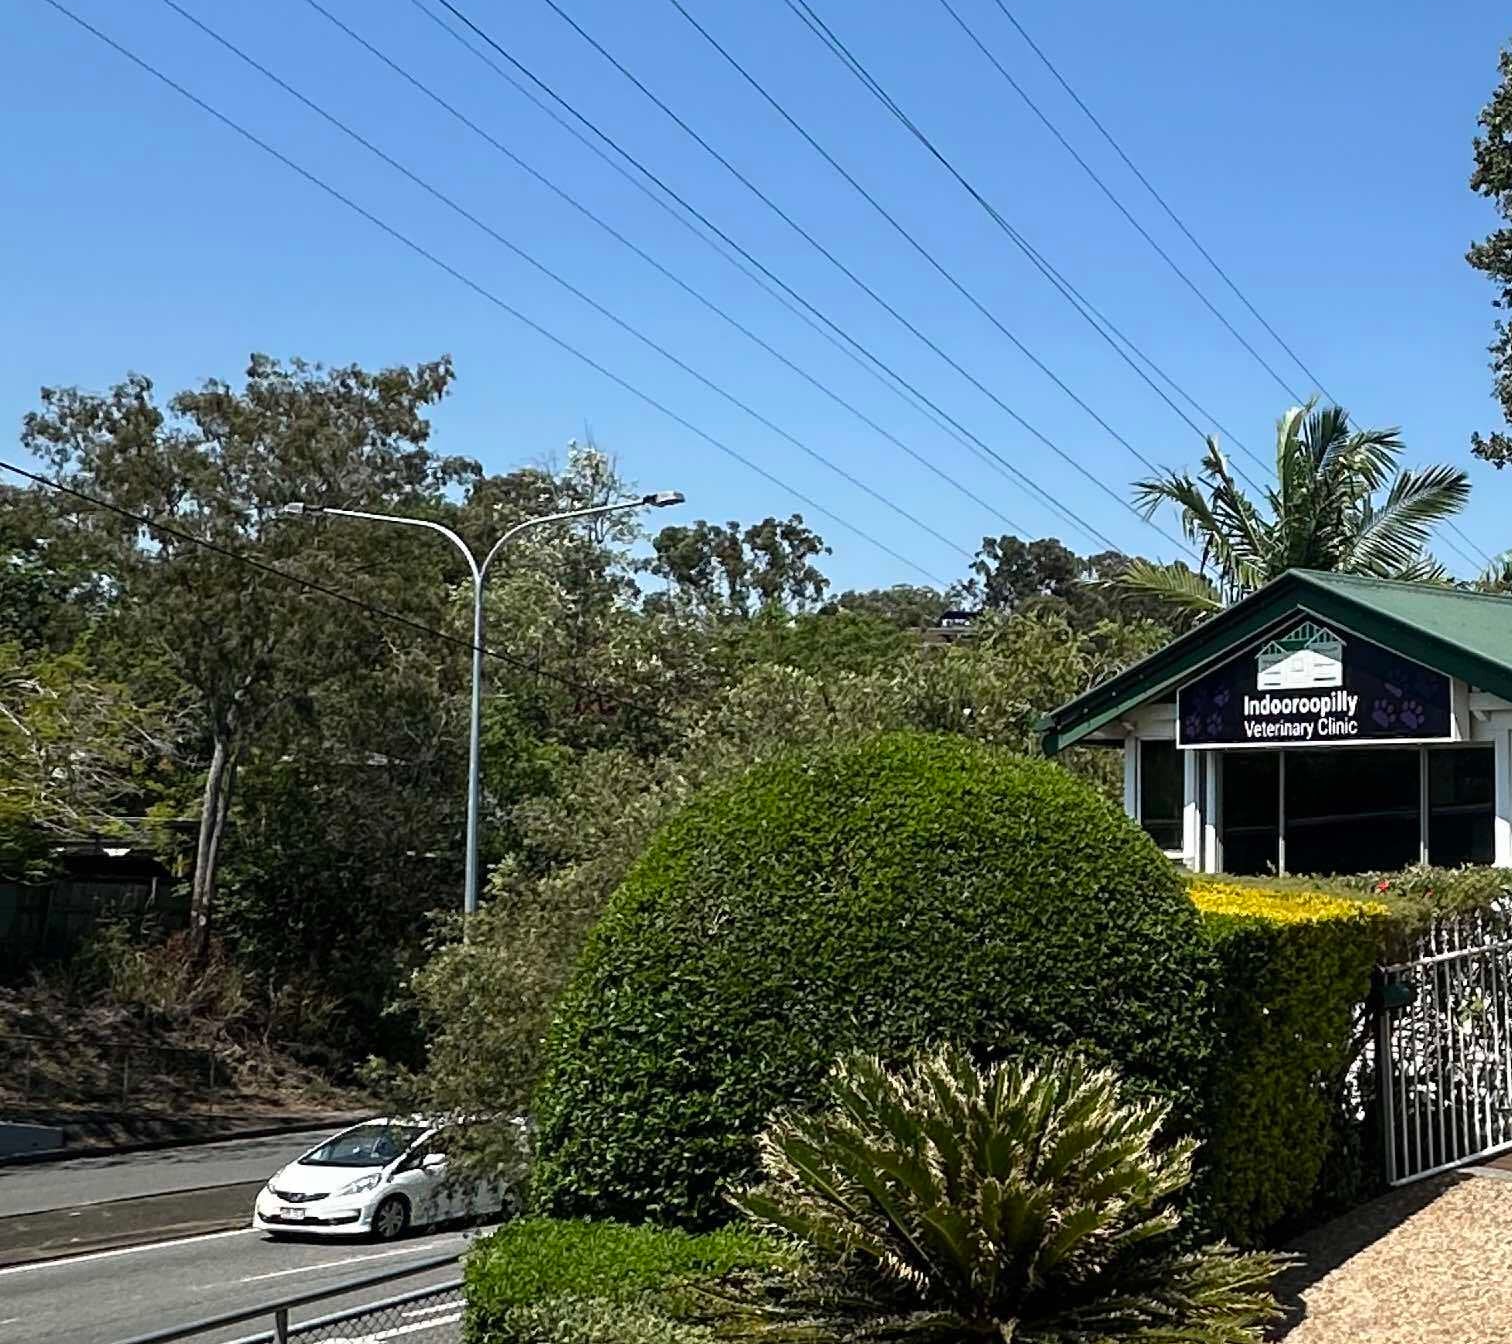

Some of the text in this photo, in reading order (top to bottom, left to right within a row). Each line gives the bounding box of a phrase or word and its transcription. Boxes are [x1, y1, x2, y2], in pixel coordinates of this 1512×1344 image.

[1244, 690, 1358, 717] Indooroopilly
[1244, 716, 1358, 740] Veterinary Clinic
